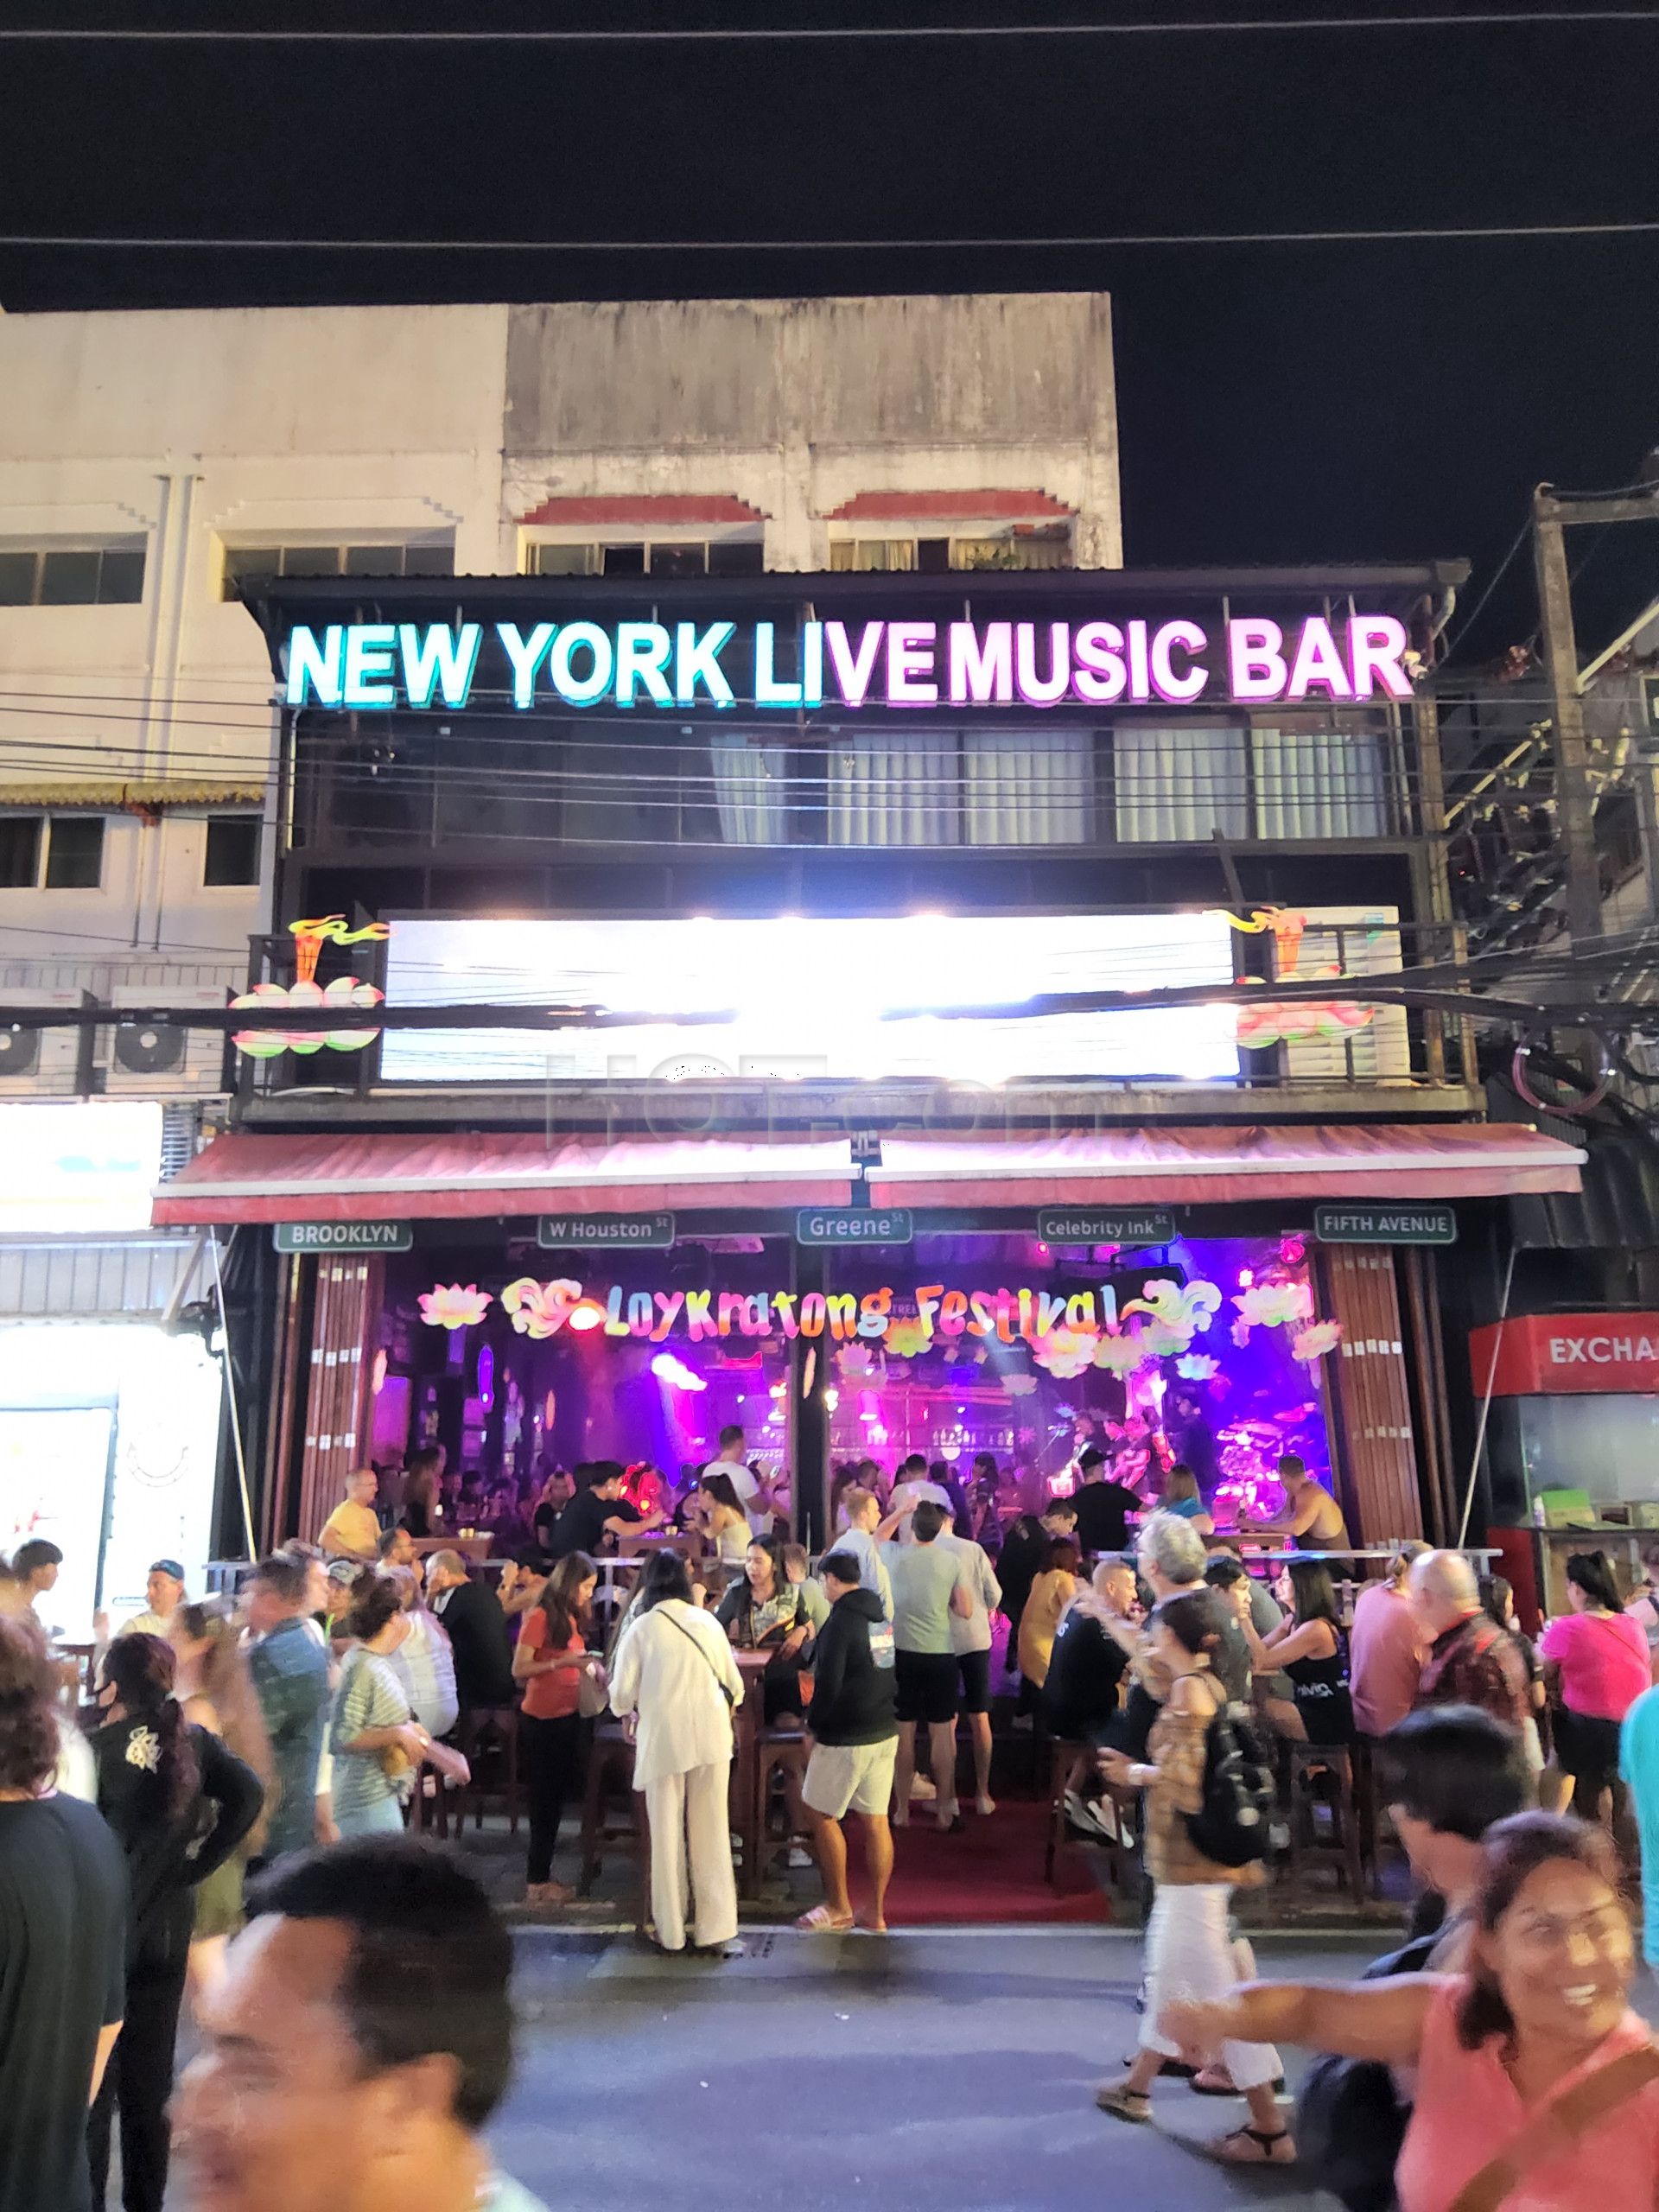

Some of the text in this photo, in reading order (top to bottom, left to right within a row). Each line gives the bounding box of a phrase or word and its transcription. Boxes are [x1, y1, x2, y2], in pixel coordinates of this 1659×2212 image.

[287, 615, 1414, 709] NEW YORK LIVE MUSIC BAR
[549, 1222, 567, 1237] W
[571, 1221, 652, 1238] Houston
[810, 1217, 891, 1236] Greene
[1046, 1220, 1123, 1238] Celebrity
[1128, 1219, 1154, 1235] Ink
[1323, 1215, 1448, 1233] FIFTH AVENUE
[291, 1224, 398, 1244] BROOKLYN
[915, 1284, 1124, 1344] Festival
[1548, 1336, 1654, 1364] EXCHA
